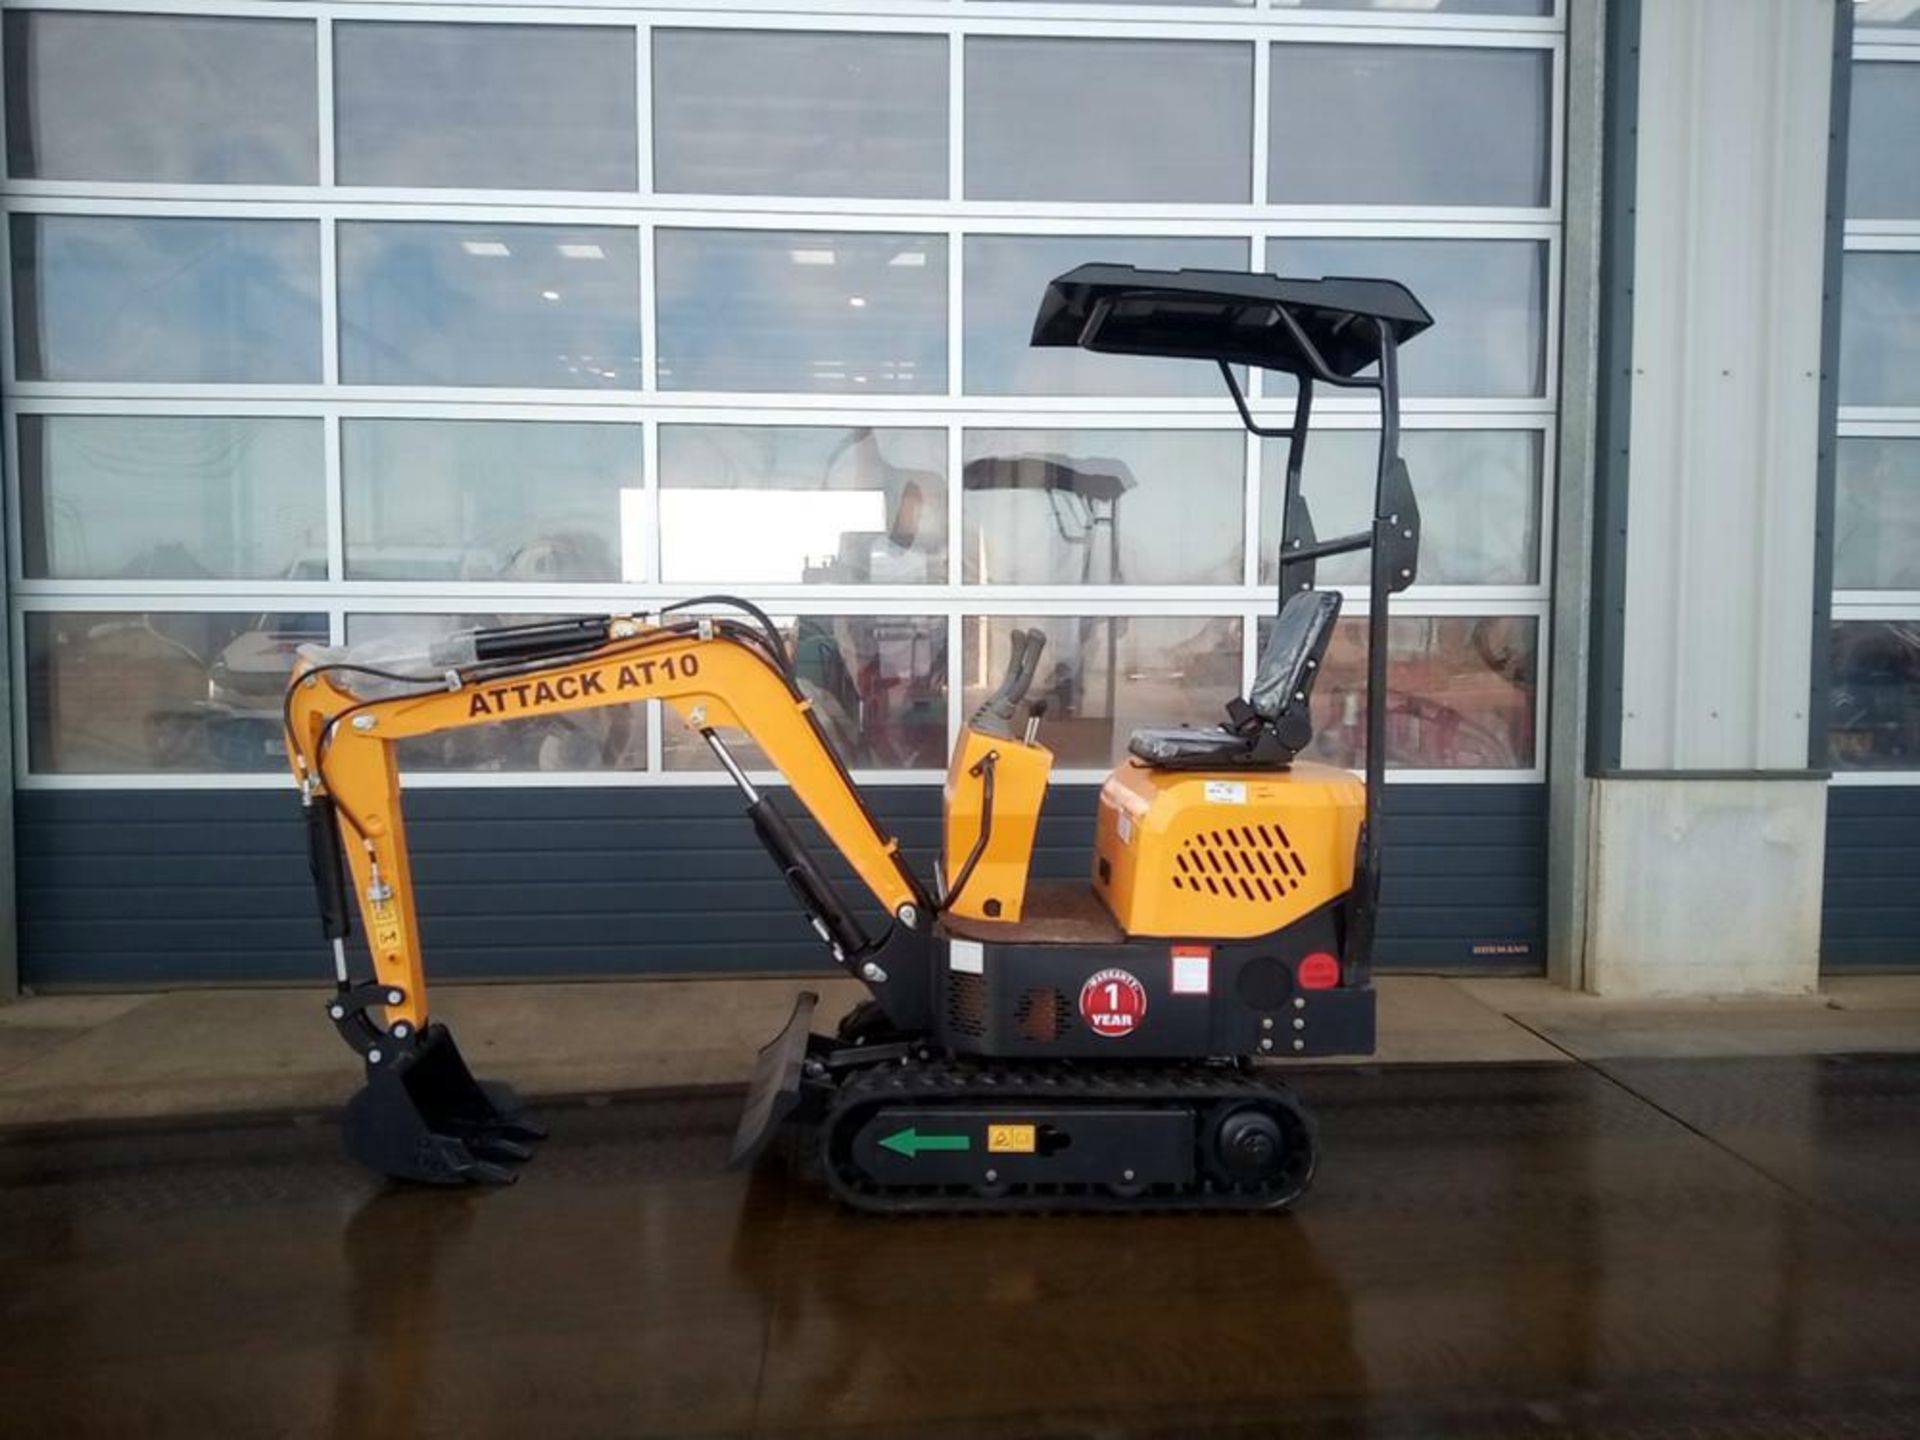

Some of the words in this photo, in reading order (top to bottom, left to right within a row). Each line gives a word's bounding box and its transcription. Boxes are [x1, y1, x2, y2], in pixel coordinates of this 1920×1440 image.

[469, 671, 606, 717] ATTACK
[617, 653, 699, 690] AT10
[1105, 983, 1118, 1010] 1
[1092, 1014, 1132, 1026] YEAR
